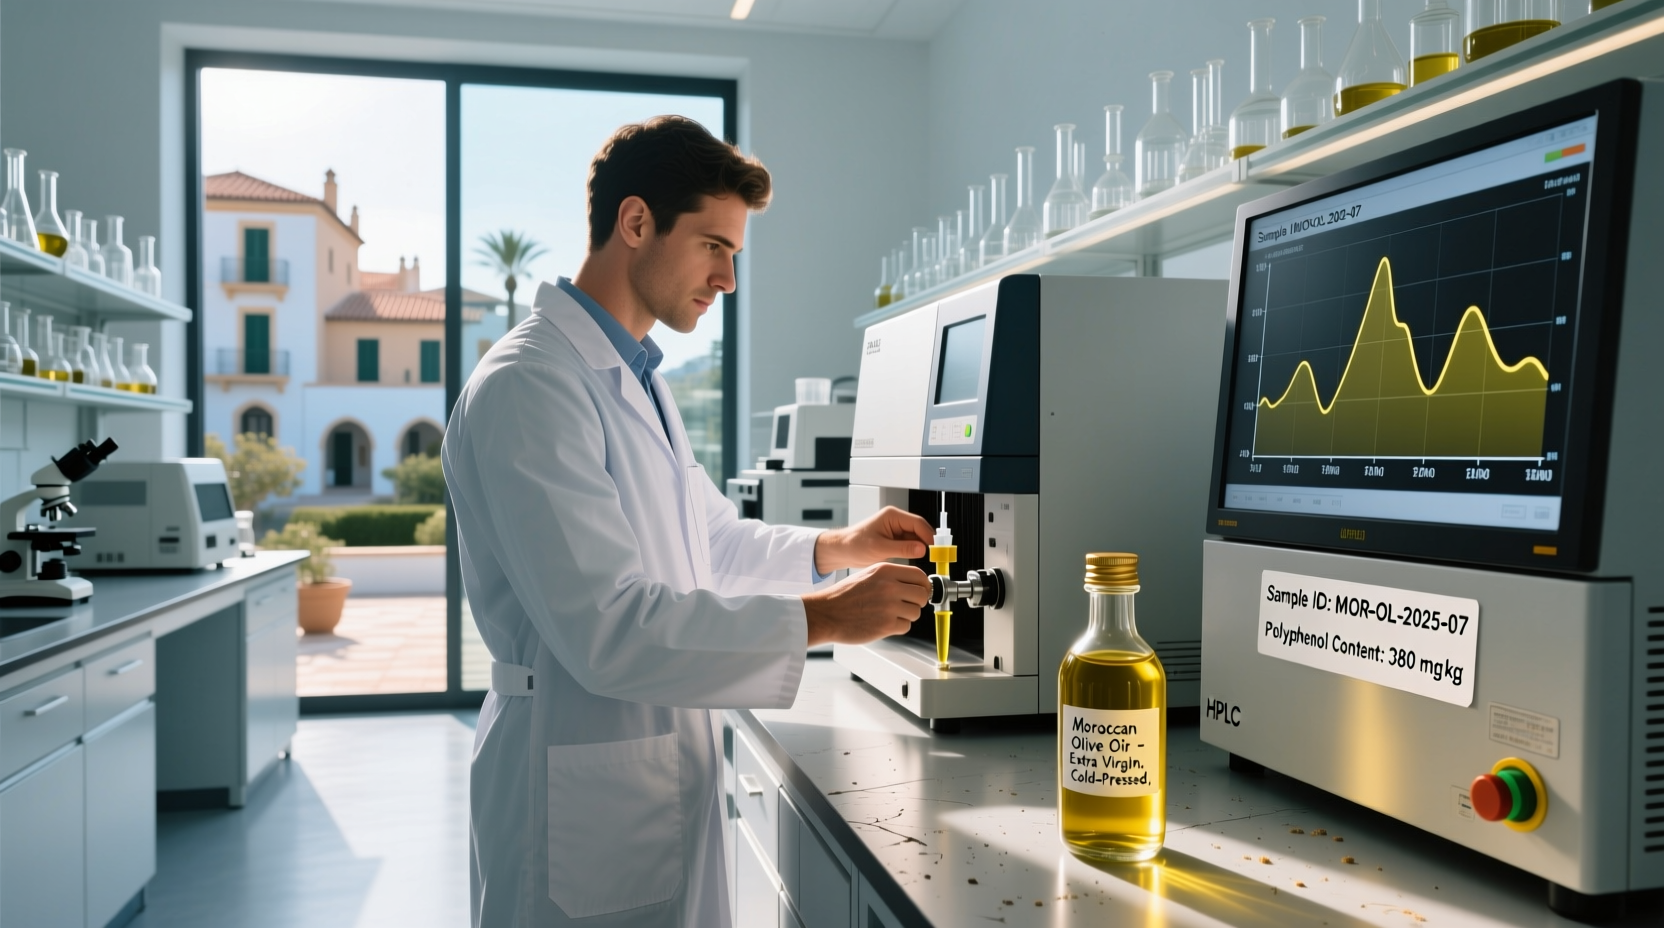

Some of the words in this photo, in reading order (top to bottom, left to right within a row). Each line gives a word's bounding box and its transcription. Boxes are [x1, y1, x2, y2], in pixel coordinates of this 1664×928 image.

[1266, 584, 1309, 609] Sample
[1312, 590, 1332, 612] ID:
[1335, 595, 1469, 636] MOR-OL-2025-07
[1265, 620, 1329, 650] Polyphenol
[1332, 634, 1385, 663] Content:
[1388, 647, 1415, 670] 380
[1206, 697, 1242, 728] HPLC
[1072, 716, 1137, 735] Moroccan
[1071, 735, 1104, 752] Olive
[1069, 751, 1098, 768] Extra
